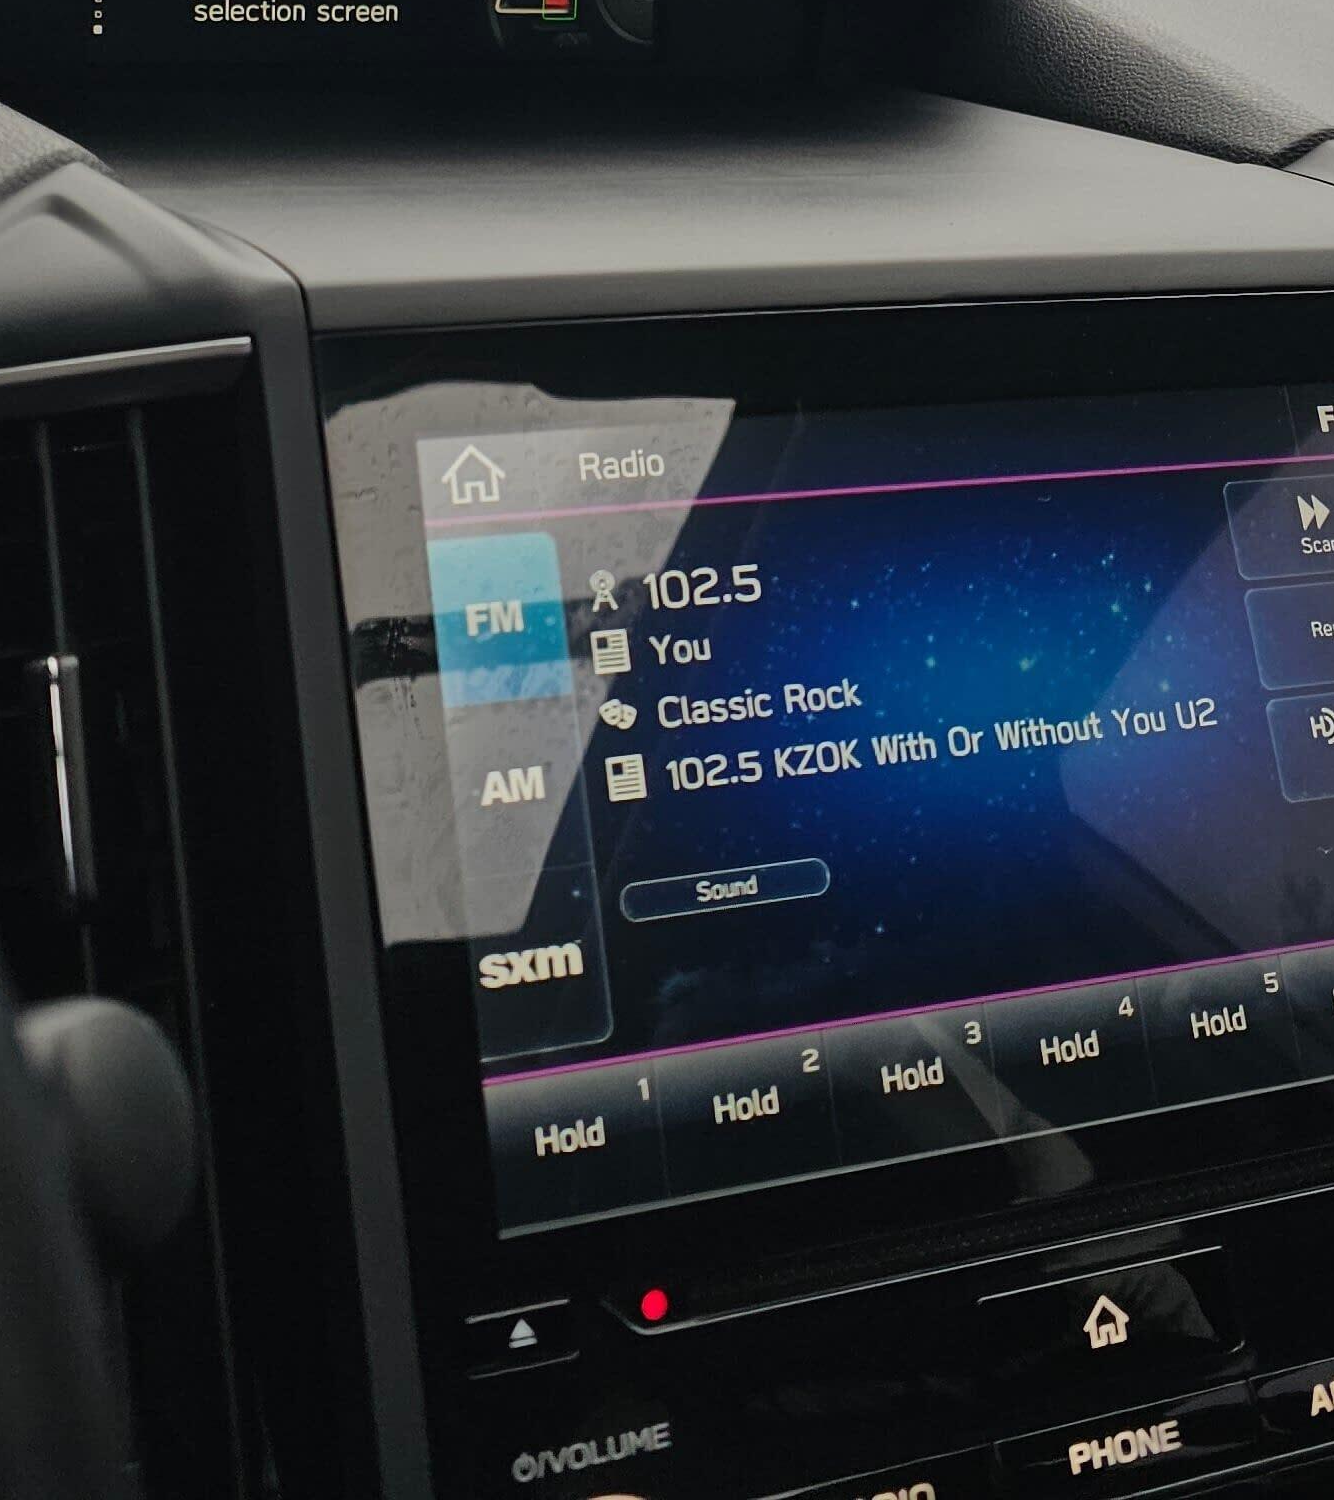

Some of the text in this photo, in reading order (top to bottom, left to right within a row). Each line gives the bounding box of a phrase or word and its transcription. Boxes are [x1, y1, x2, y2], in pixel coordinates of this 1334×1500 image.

[316, 4, 399, 23] screen
[577, 448, 666, 483] Radio
[642, 563, 763, 611] 102.5
[465, 599, 525, 638] FM
[648, 634, 712, 665] You
[657, 677, 863, 729] Classic Rock
[665, 697, 1218, 791] 102.5 KZOK With Or Without You U2
[479, 765, 546, 808] AM
[694, 873, 761, 903] Sound
[477, 941, 584, 990] sxm
[1190, 971, 1279, 1039] Hold 5
[1039, 995, 1135, 1066] Hold 4
[880, 1021, 983, 1094] Hold 3
[712, 1047, 821, 1125] Hold 2
[534, 1076, 650, 1157] Hold 1
[1068, 1420, 1182, 1475] PHONE
